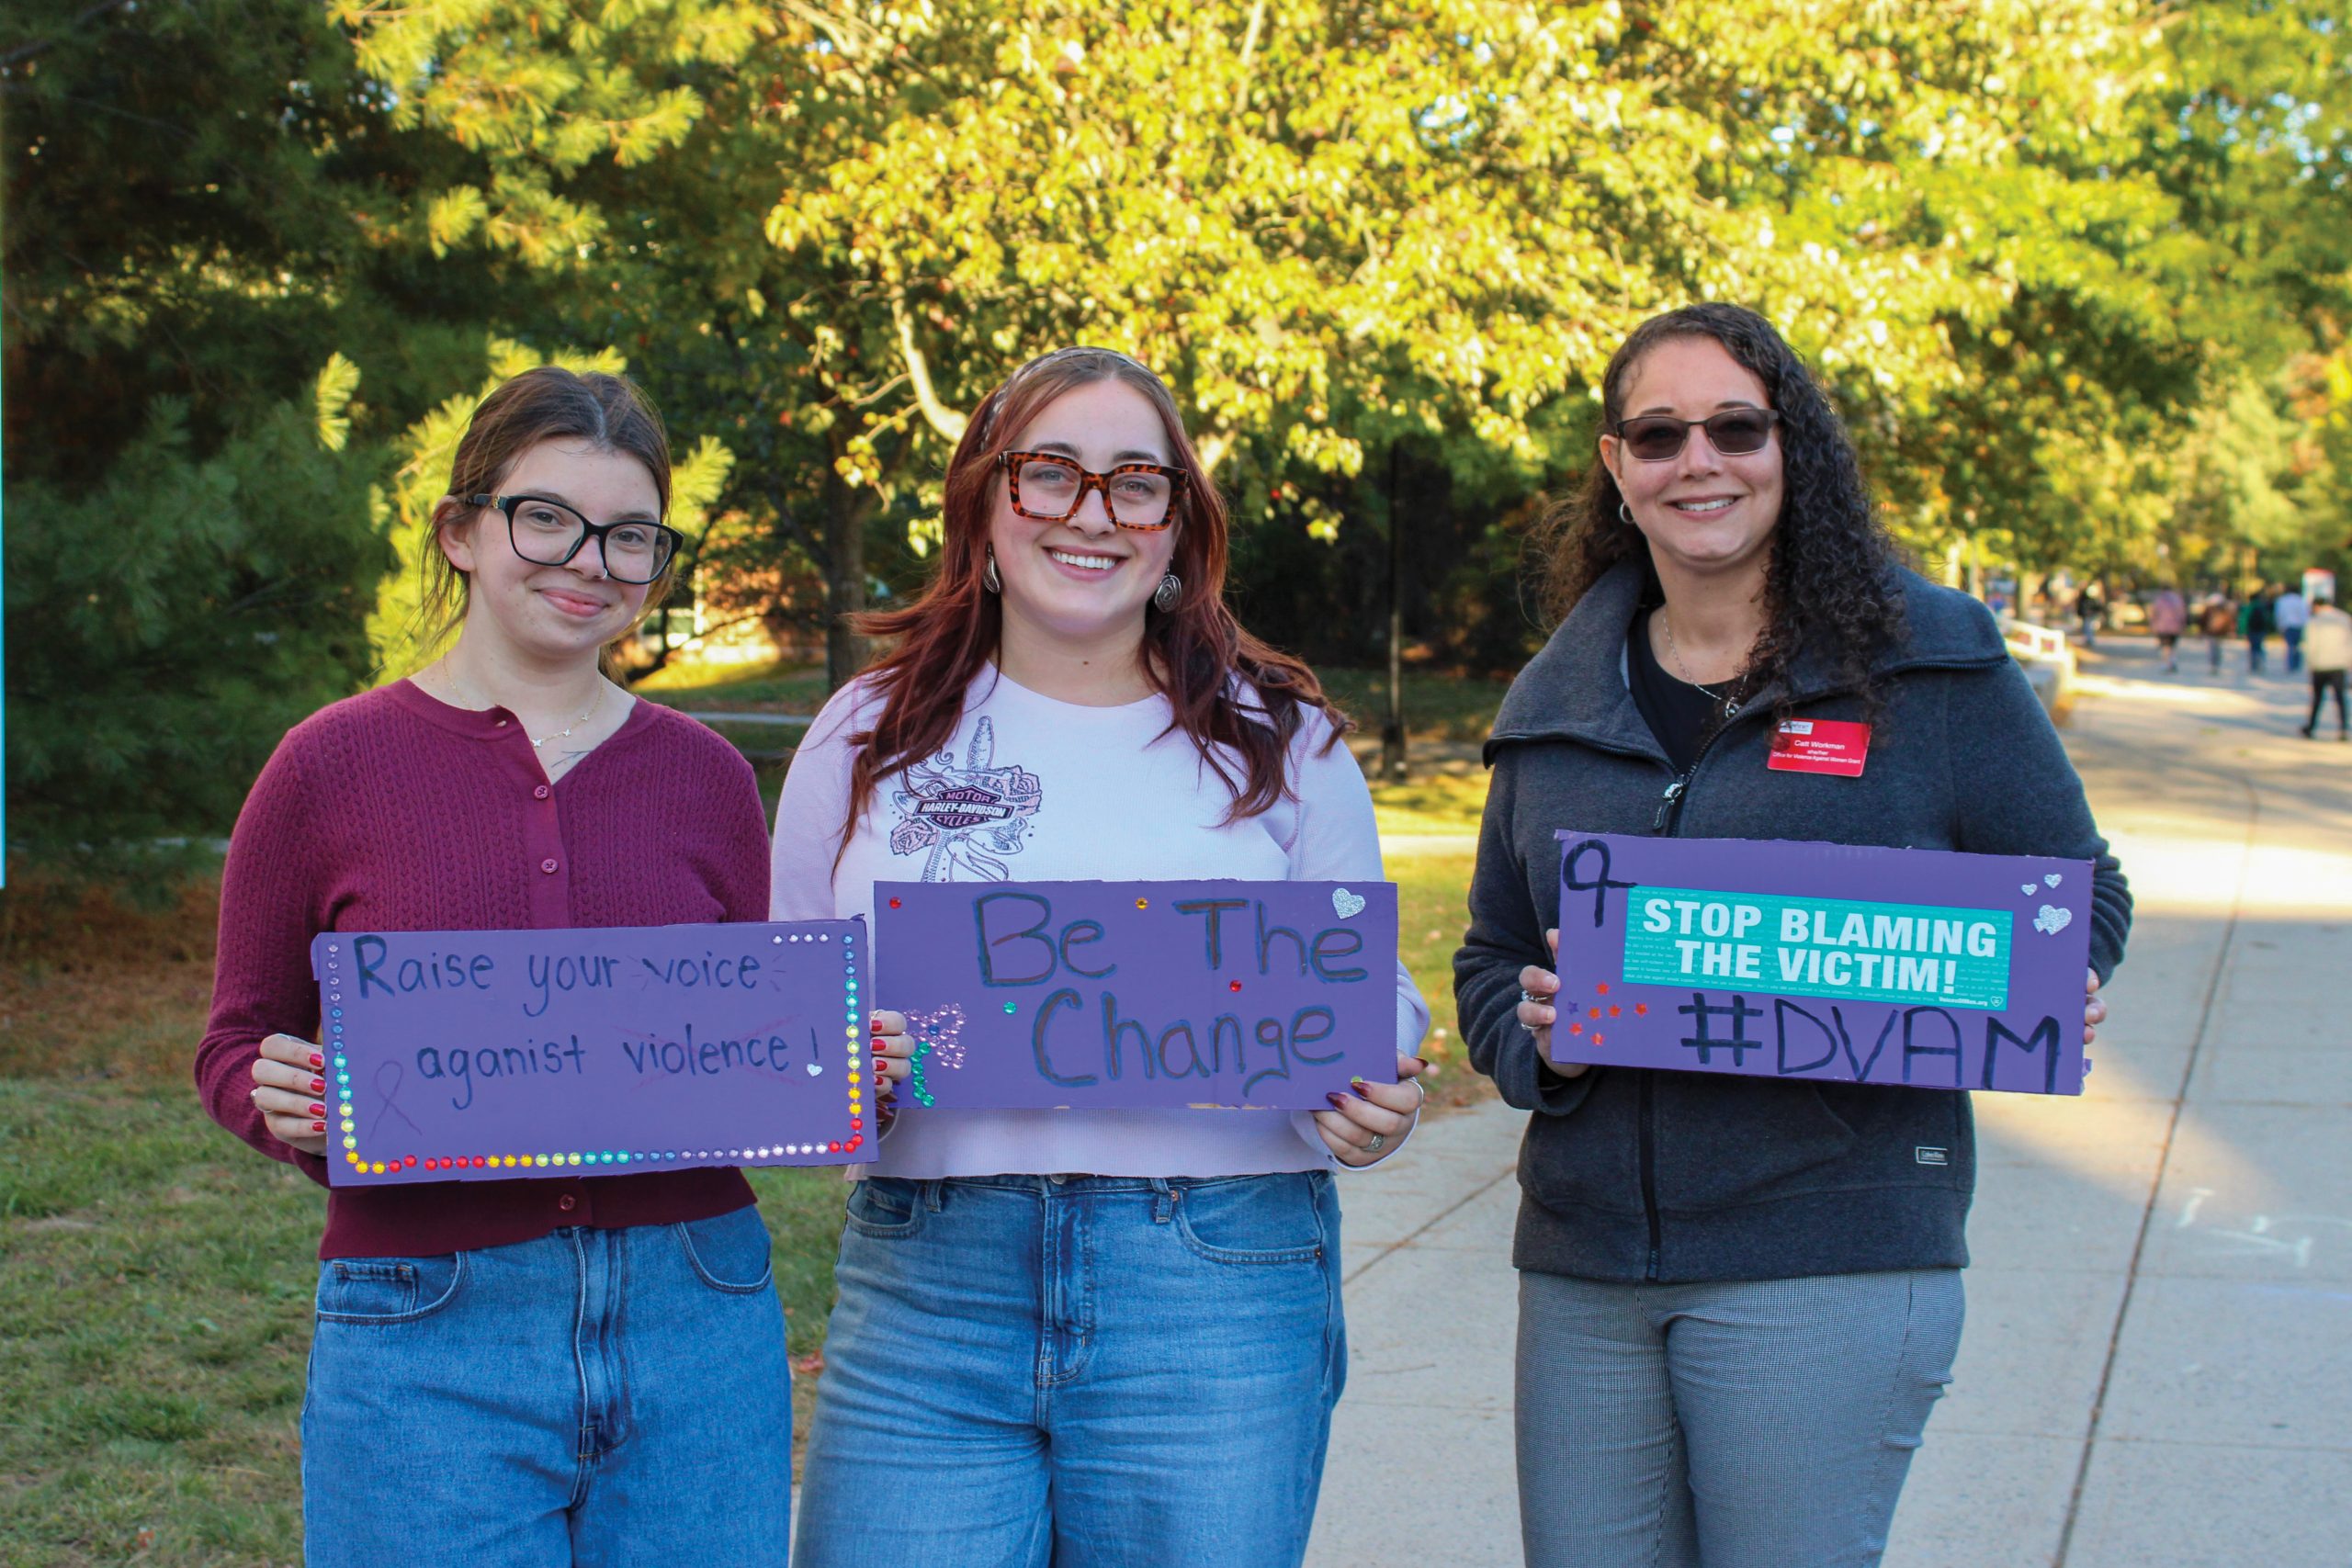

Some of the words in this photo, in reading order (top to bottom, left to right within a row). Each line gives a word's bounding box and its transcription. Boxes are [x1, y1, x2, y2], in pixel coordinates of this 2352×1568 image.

[922, 803, 1006, 817] HARLEY-DAVIDSON
[936, 814, 981, 827] CYCLES
[945, 790, 991, 803] MOTOR
[973, 892, 1117, 987] Be
[1172, 897, 1368, 983] The
[1642, 897, 1762, 939] STOP
[1779, 908, 1997, 958] BLAMING
[352, 934, 494, 999] Raise
[523, 953, 620, 1017] your
[642, 951, 762, 988] voice
[1675, 939, 1762, 979] THE
[1777, 946, 1957, 995] VICTIM!
[416, 1033, 585, 1111] aganist
[1032, 988, 1344, 1098] Change
[1678, 992, 2062, 1095] #DVAM
